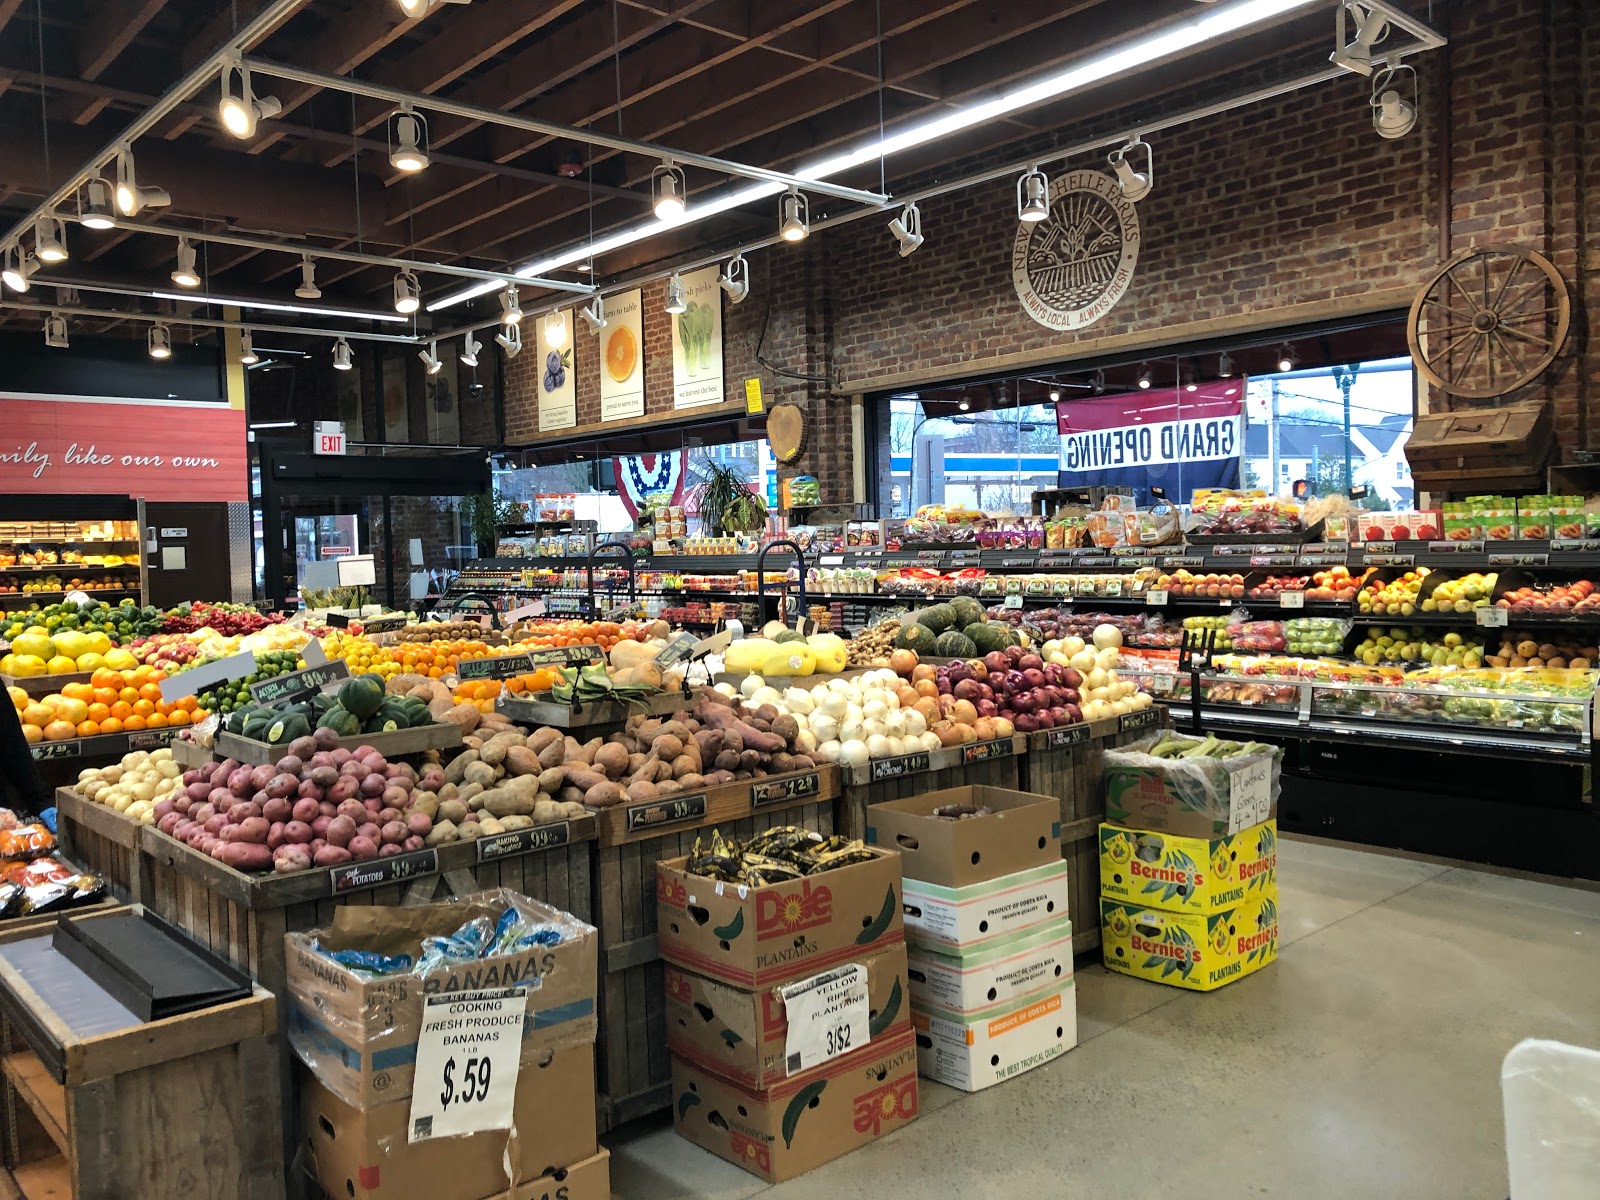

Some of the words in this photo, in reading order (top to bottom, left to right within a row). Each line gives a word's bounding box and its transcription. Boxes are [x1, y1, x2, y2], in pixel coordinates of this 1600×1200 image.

[1014, 226, 1031, 271] NEW
[1042, 173, 1106, 201] CHELLE
[1105, 184, 1139, 243] FARMS
[695, 283, 712, 297] picks
[1022, 290, 1047, 320] ALWAYS
[1047, 313, 1071, 327] LOCAL
[1078, 299, 1110, 324] ALWAYS
[1108, 268, 1130, 301] FRESH
[603, 308, 616, 319] farm
[623, 303, 638, 314] table
[685, 388, 700, 398] harvest
[700, 386, 708, 395] the
[708, 385, 718, 394] best
[65, 443, 115, 465] like
[121, 454, 165, 467] our
[171, 456, 220, 468] own
[321, 435, 342, 453] EXIT
[258, 683, 279, 699] ACORN
[352, 871, 384, 886] POTATOES
[1130, 860, 1204, 886] Bernie's
[1239, 854, 1276, 881] Bernie's
[656, 872, 687, 902] Dole
[1102, 883, 1129, 896] PLANTAINS
[1210, 887, 1244, 907] PLANTAINS
[756, 879, 833, 932] Dole
[987, 904, 1012, 916] PRODUCT
[1020, 898, 1036, 907] COSTA
[1036, 894, 1048, 902] RICA
[1002, 911, 1021, 920] PREMIUM
[1021, 905, 1039, 916] QUALITY
[1131, 935, 1202, 962] Bernie's
[1237, 924, 1278, 955] Bernie's
[757, 941, 818, 969] PLANTAINS
[297, 950, 347, 992] BANANAS
[423, 953, 556, 995] BANANAS
[995, 970, 1020, 983] PRODUCT
[1029, 962, 1044, 972] COSTA
[1044, 957, 1055, 966] RICA
[1011, 976, 1030, 987] PREMIUM
[1030, 969, 1047, 981] QUALITY
[1209, 961, 1242, 984] PLANTAINS
[450, 993, 465, 1002] KEY
[465, 992, 482, 1001] BUY
[816, 974, 858, 996] YELLOW
[827, 989, 850, 1004] RIPE
[449, 1001, 503, 1014] COOKING
[811, 993, 865, 1021] PLANTAINS
[1019, 1012, 1027, 1021] OF
[1028, 1005, 1047, 1018] COSTA
[425, 1018, 463, 1033] FRESH
[466, 1014, 522, 1028] PRODUCE
[443, 1031, 500, 1046] BANANAS
[826, 1023, 851, 1056] 3/$2
[865, 1048, 917, 1080] PLANTAINS
[995, 1068, 1007, 1080] THE
[1006, 1062, 1020, 1075] BEST
[1020, 1052, 1045, 1069] TROPICAL
[1044, 1043, 1063, 1058] QUALITY
[440, 1056, 492, 1112] $.59
[853, 1077, 918, 1136] Dole
